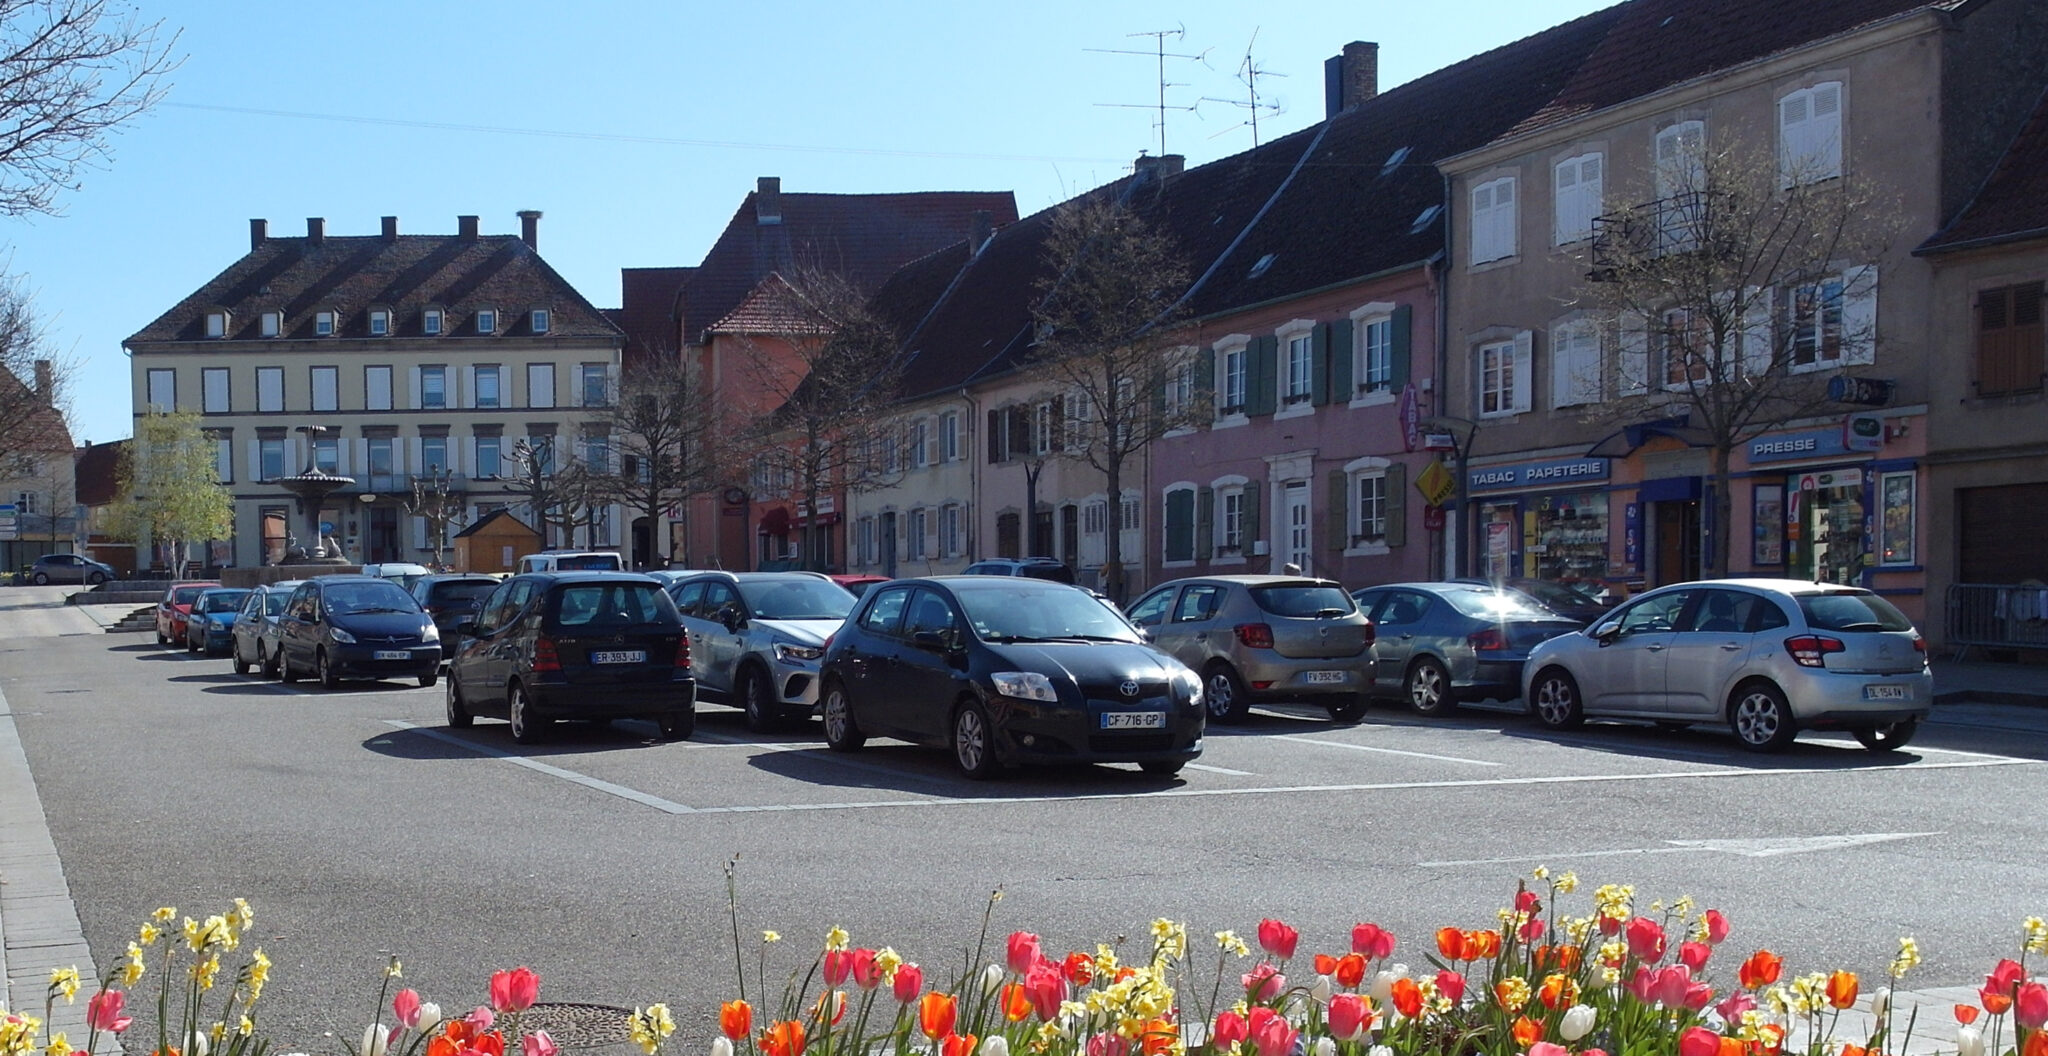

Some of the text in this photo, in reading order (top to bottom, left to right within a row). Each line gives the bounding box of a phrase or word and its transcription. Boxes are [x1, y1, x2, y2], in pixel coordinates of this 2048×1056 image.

[1408, 389, 1417, 446] TABAC
[1753, 438, 1815, 455] PRESSE
[1472, 462, 1601, 485] TABAC PAPETERIE
